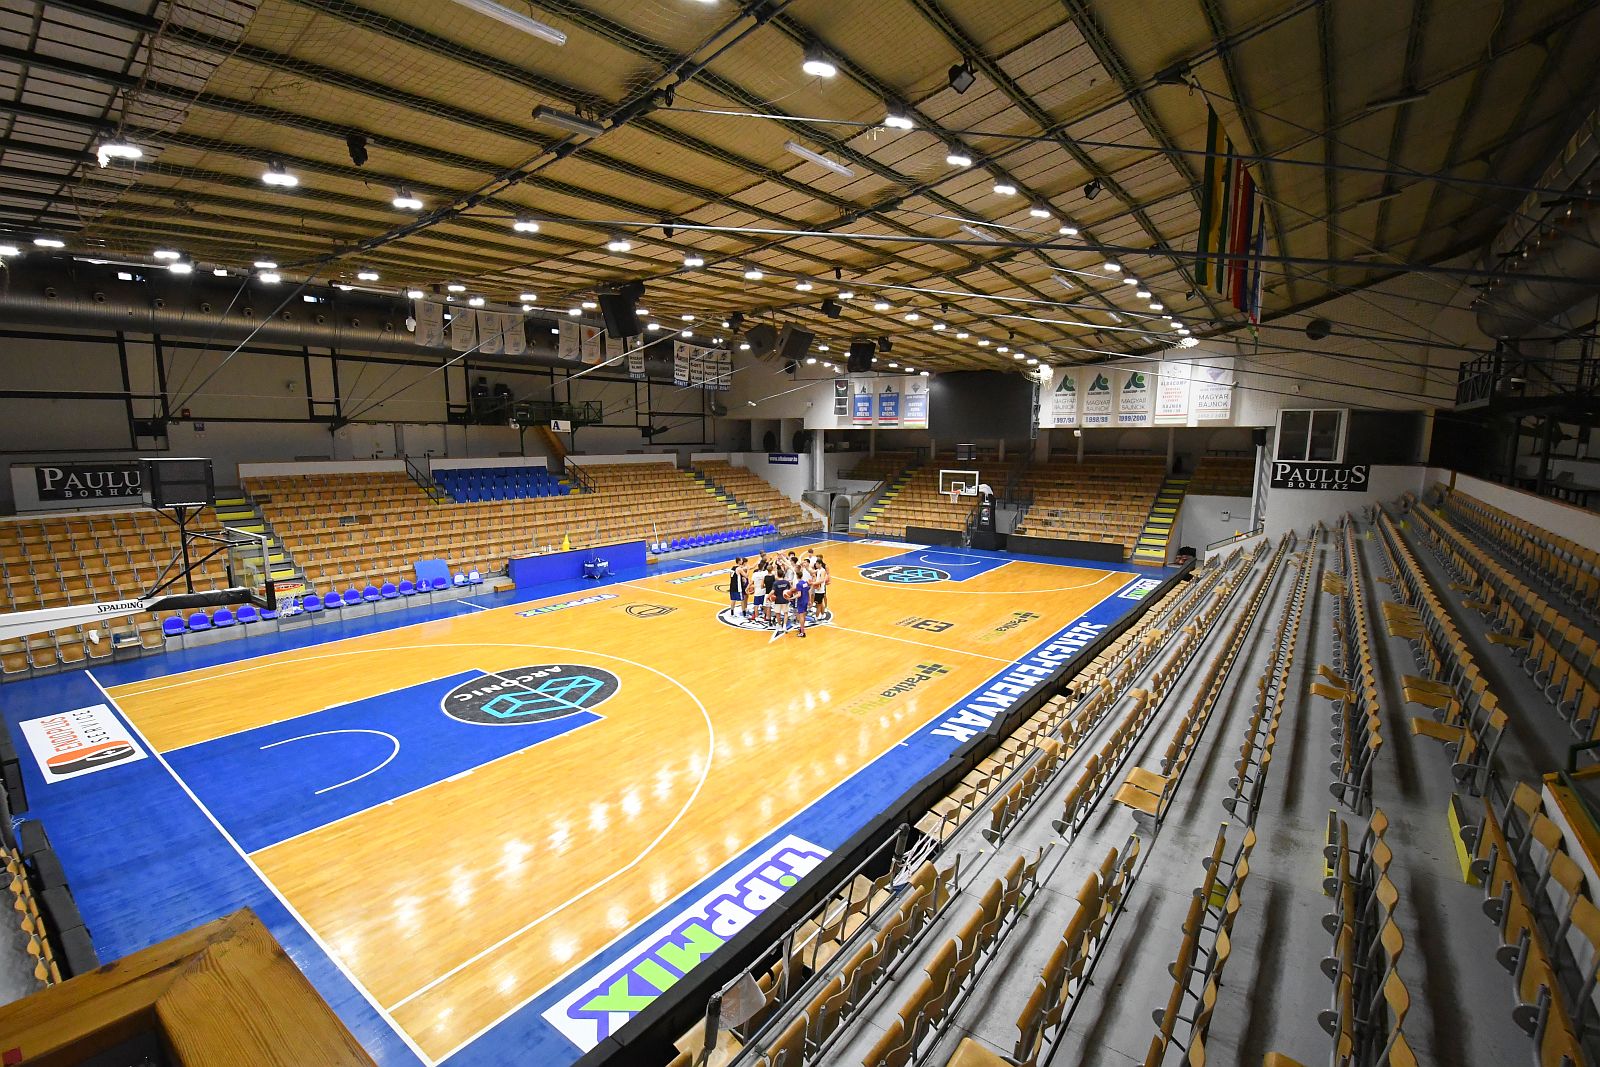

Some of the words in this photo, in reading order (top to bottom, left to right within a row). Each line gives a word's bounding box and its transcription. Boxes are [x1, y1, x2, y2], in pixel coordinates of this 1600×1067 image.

[552, 420, 561, 430] A
[40, 467, 141, 491] PAULU
[1273, 463, 1367, 484] PAULUS
[1287, 481, 1349, 490] BORHÁZ
[97, 600, 143, 613] SPALDING
[453, 665, 562, 702] ARCONIC
